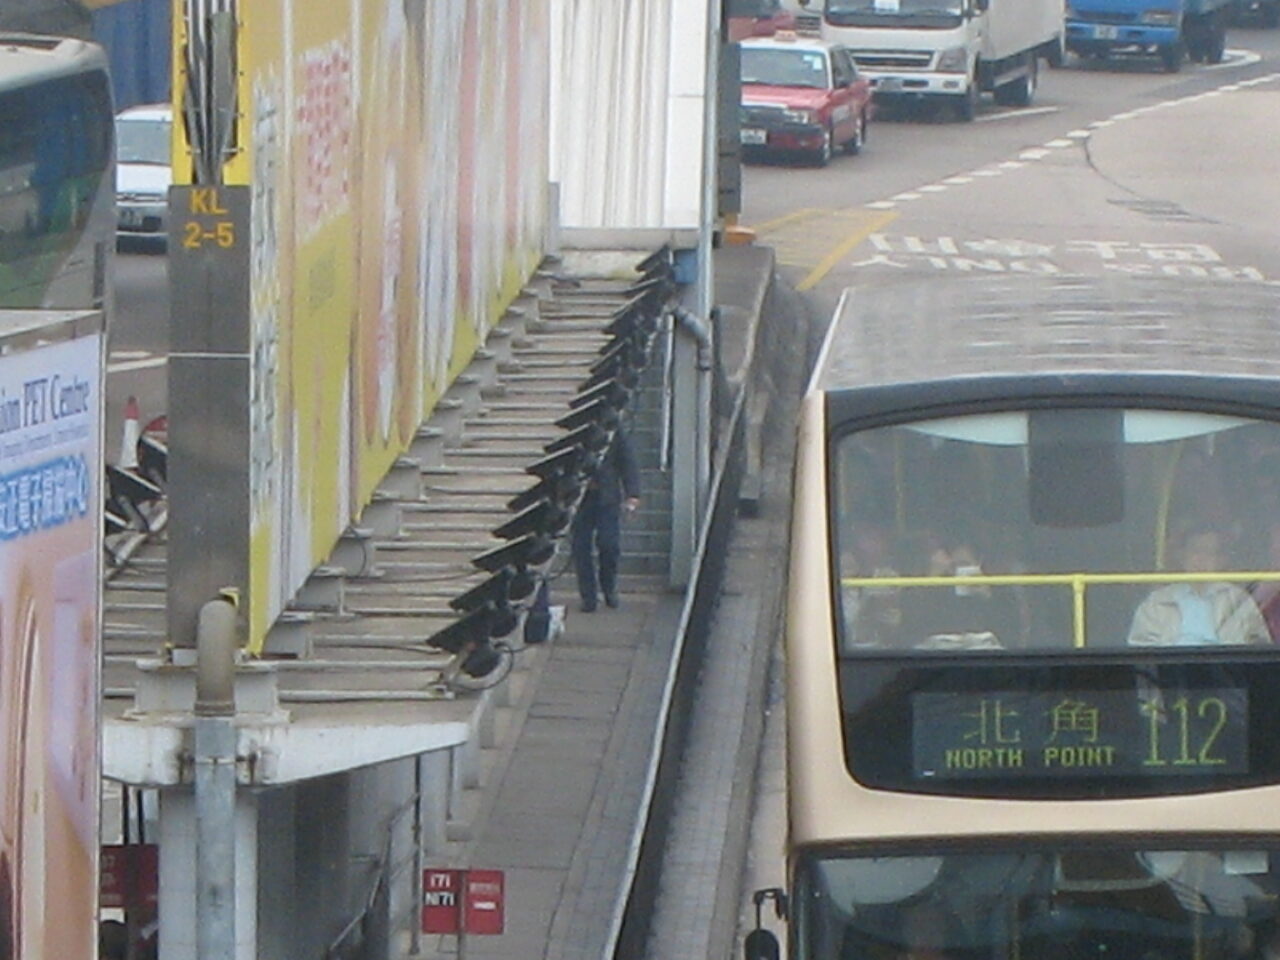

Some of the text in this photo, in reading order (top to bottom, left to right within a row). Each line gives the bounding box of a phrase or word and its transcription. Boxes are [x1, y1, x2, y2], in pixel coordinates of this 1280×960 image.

[190, 188, 229, 214] KL
[183, 221, 235, 249] 2-5
[24, 377, 48, 428] PET
[51, 373, 90, 421] Centre
[961, 699, 1100, 744] 北角
[1142, 697, 1228, 765] 112
[945, 746, 1116, 769] NORTH POINT
